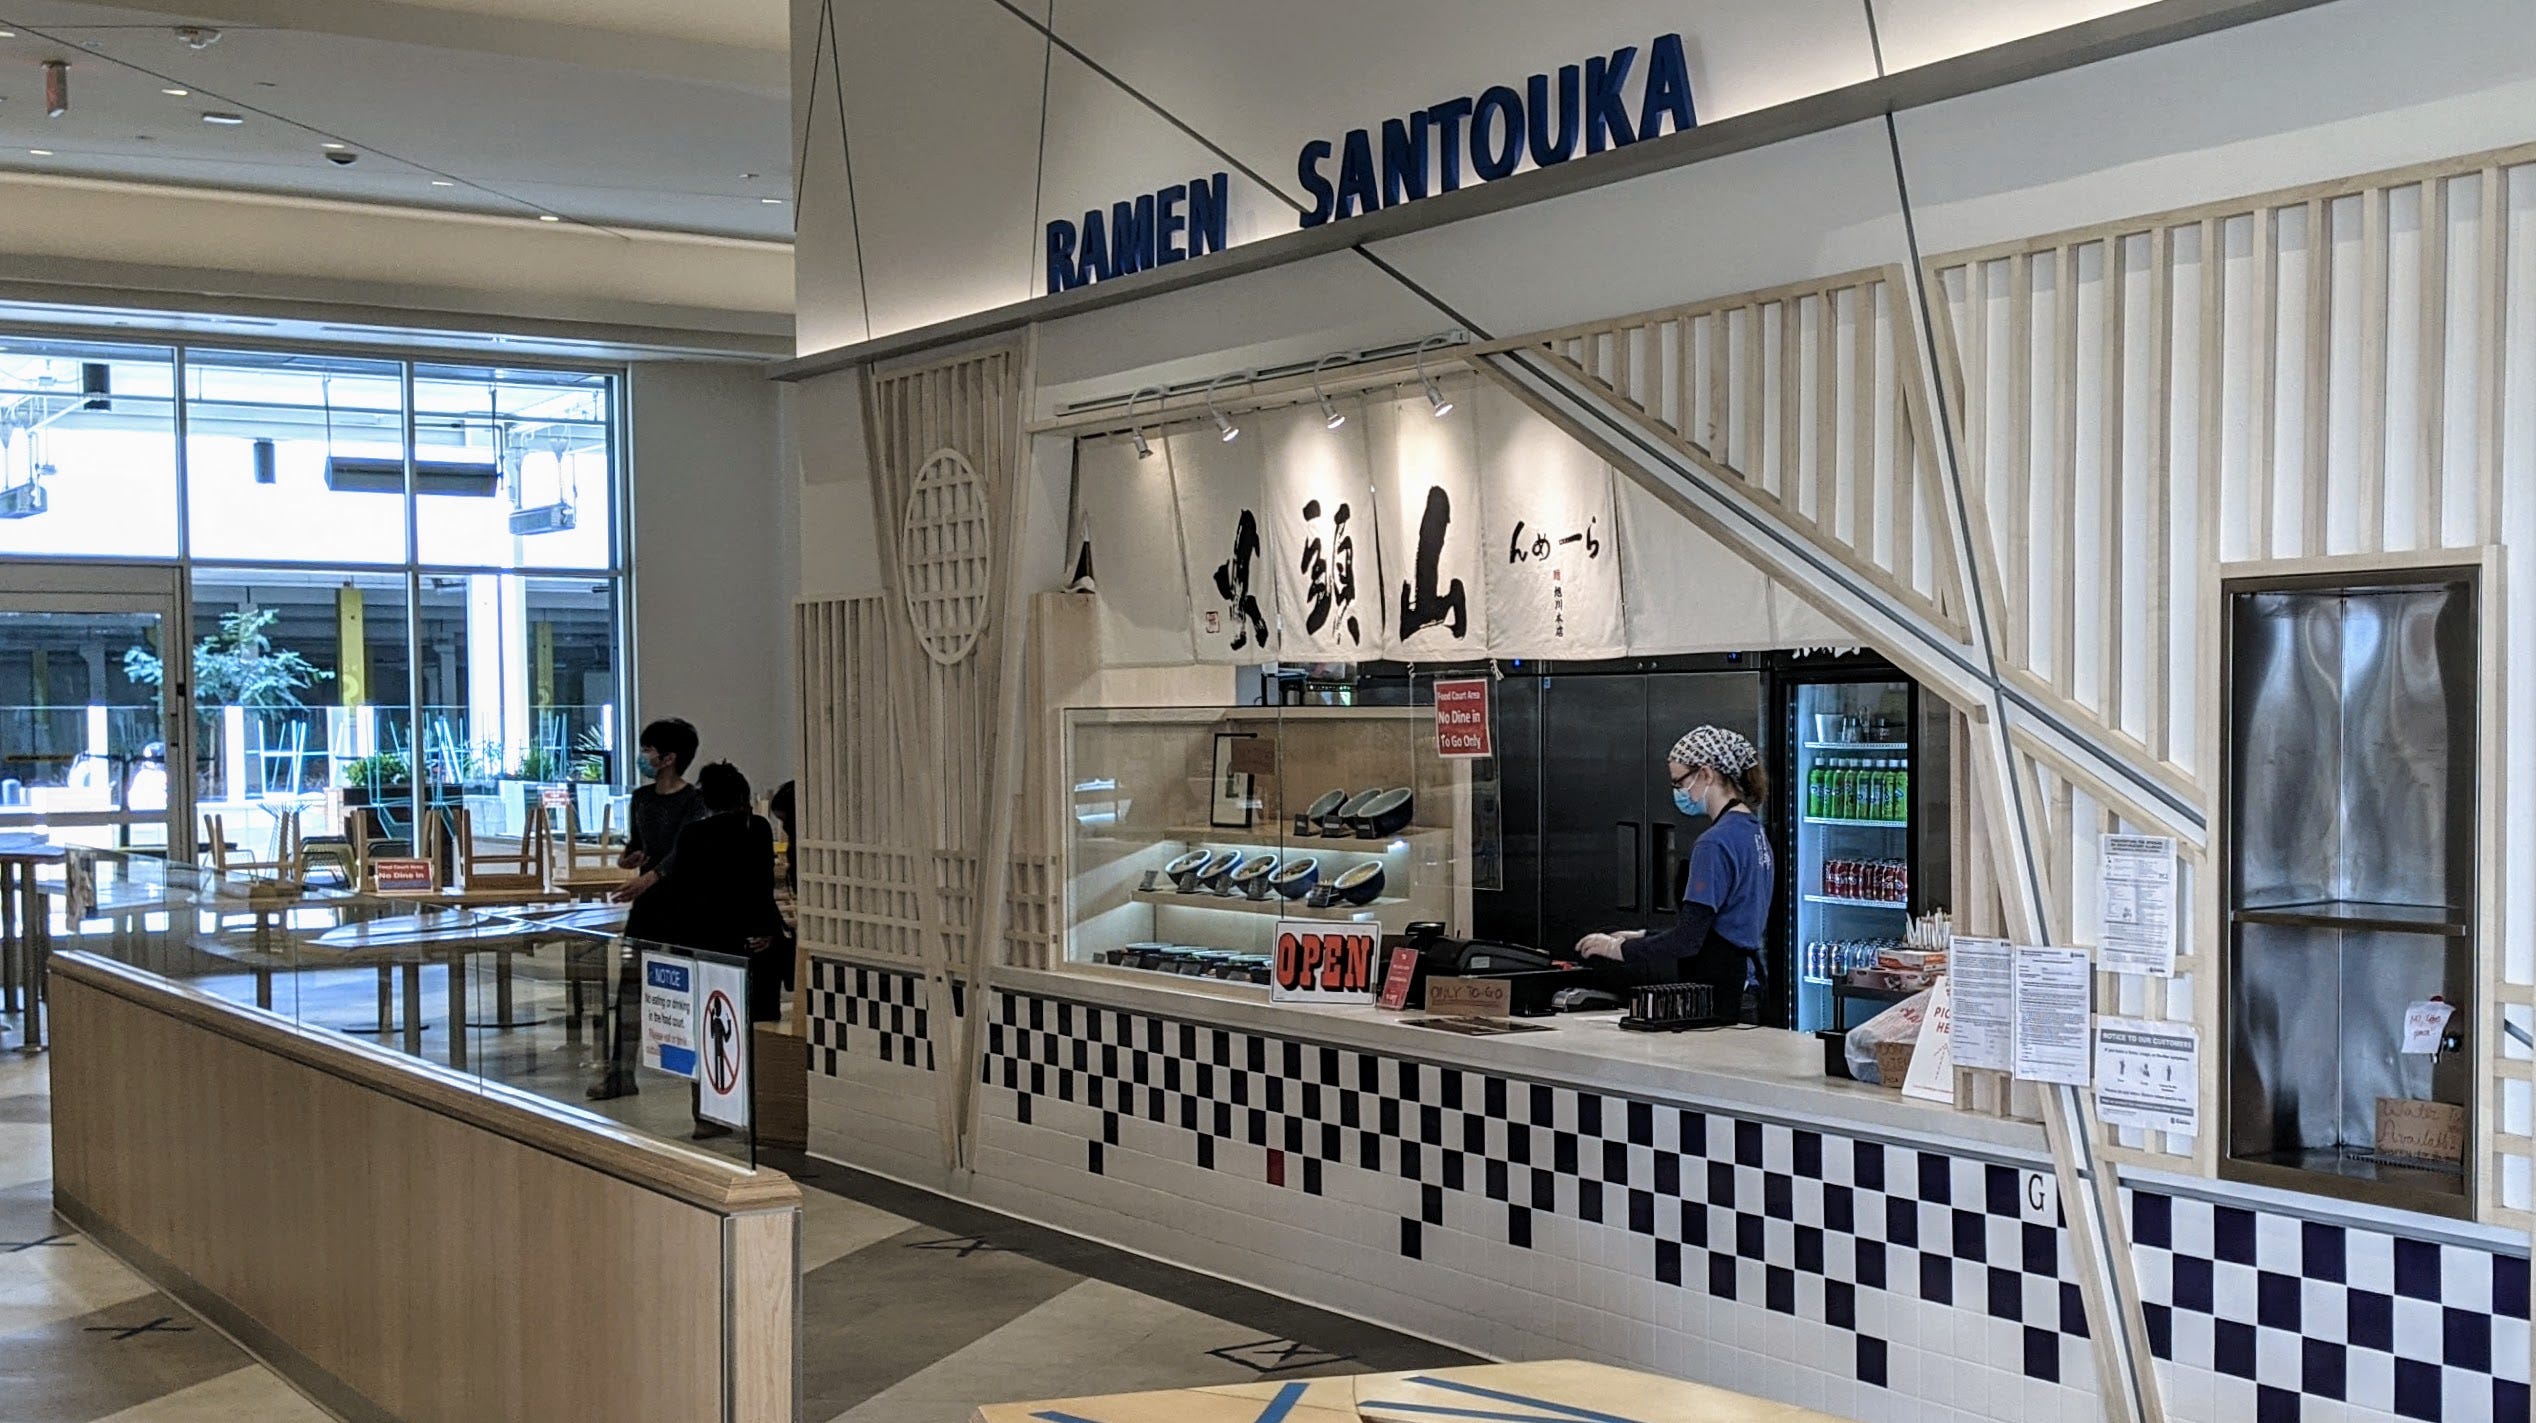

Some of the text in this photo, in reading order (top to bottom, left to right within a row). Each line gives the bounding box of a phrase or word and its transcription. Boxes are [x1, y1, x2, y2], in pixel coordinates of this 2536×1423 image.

[1046, 33, 1698, 296] RAMEN SANTOUKA
[1438, 690, 1480, 701] Food Court Area
[1438, 709, 1481, 724] No Dine in
[1440, 734, 1481, 749] To Go Only
[1276, 933, 1374, 992] OPEN
[654, 967, 681, 988] NOTICE
[1934, 1006, 1951, 1018] PIC
[1936, 1023, 1950, 1034] HE
[2102, 1031, 2126, 1043] NOTICE
[2128, 1034, 2137, 1043] TO
[2152, 1037, 2192, 1049] CUSTOMERS
[2028, 1173, 2046, 1212] G
